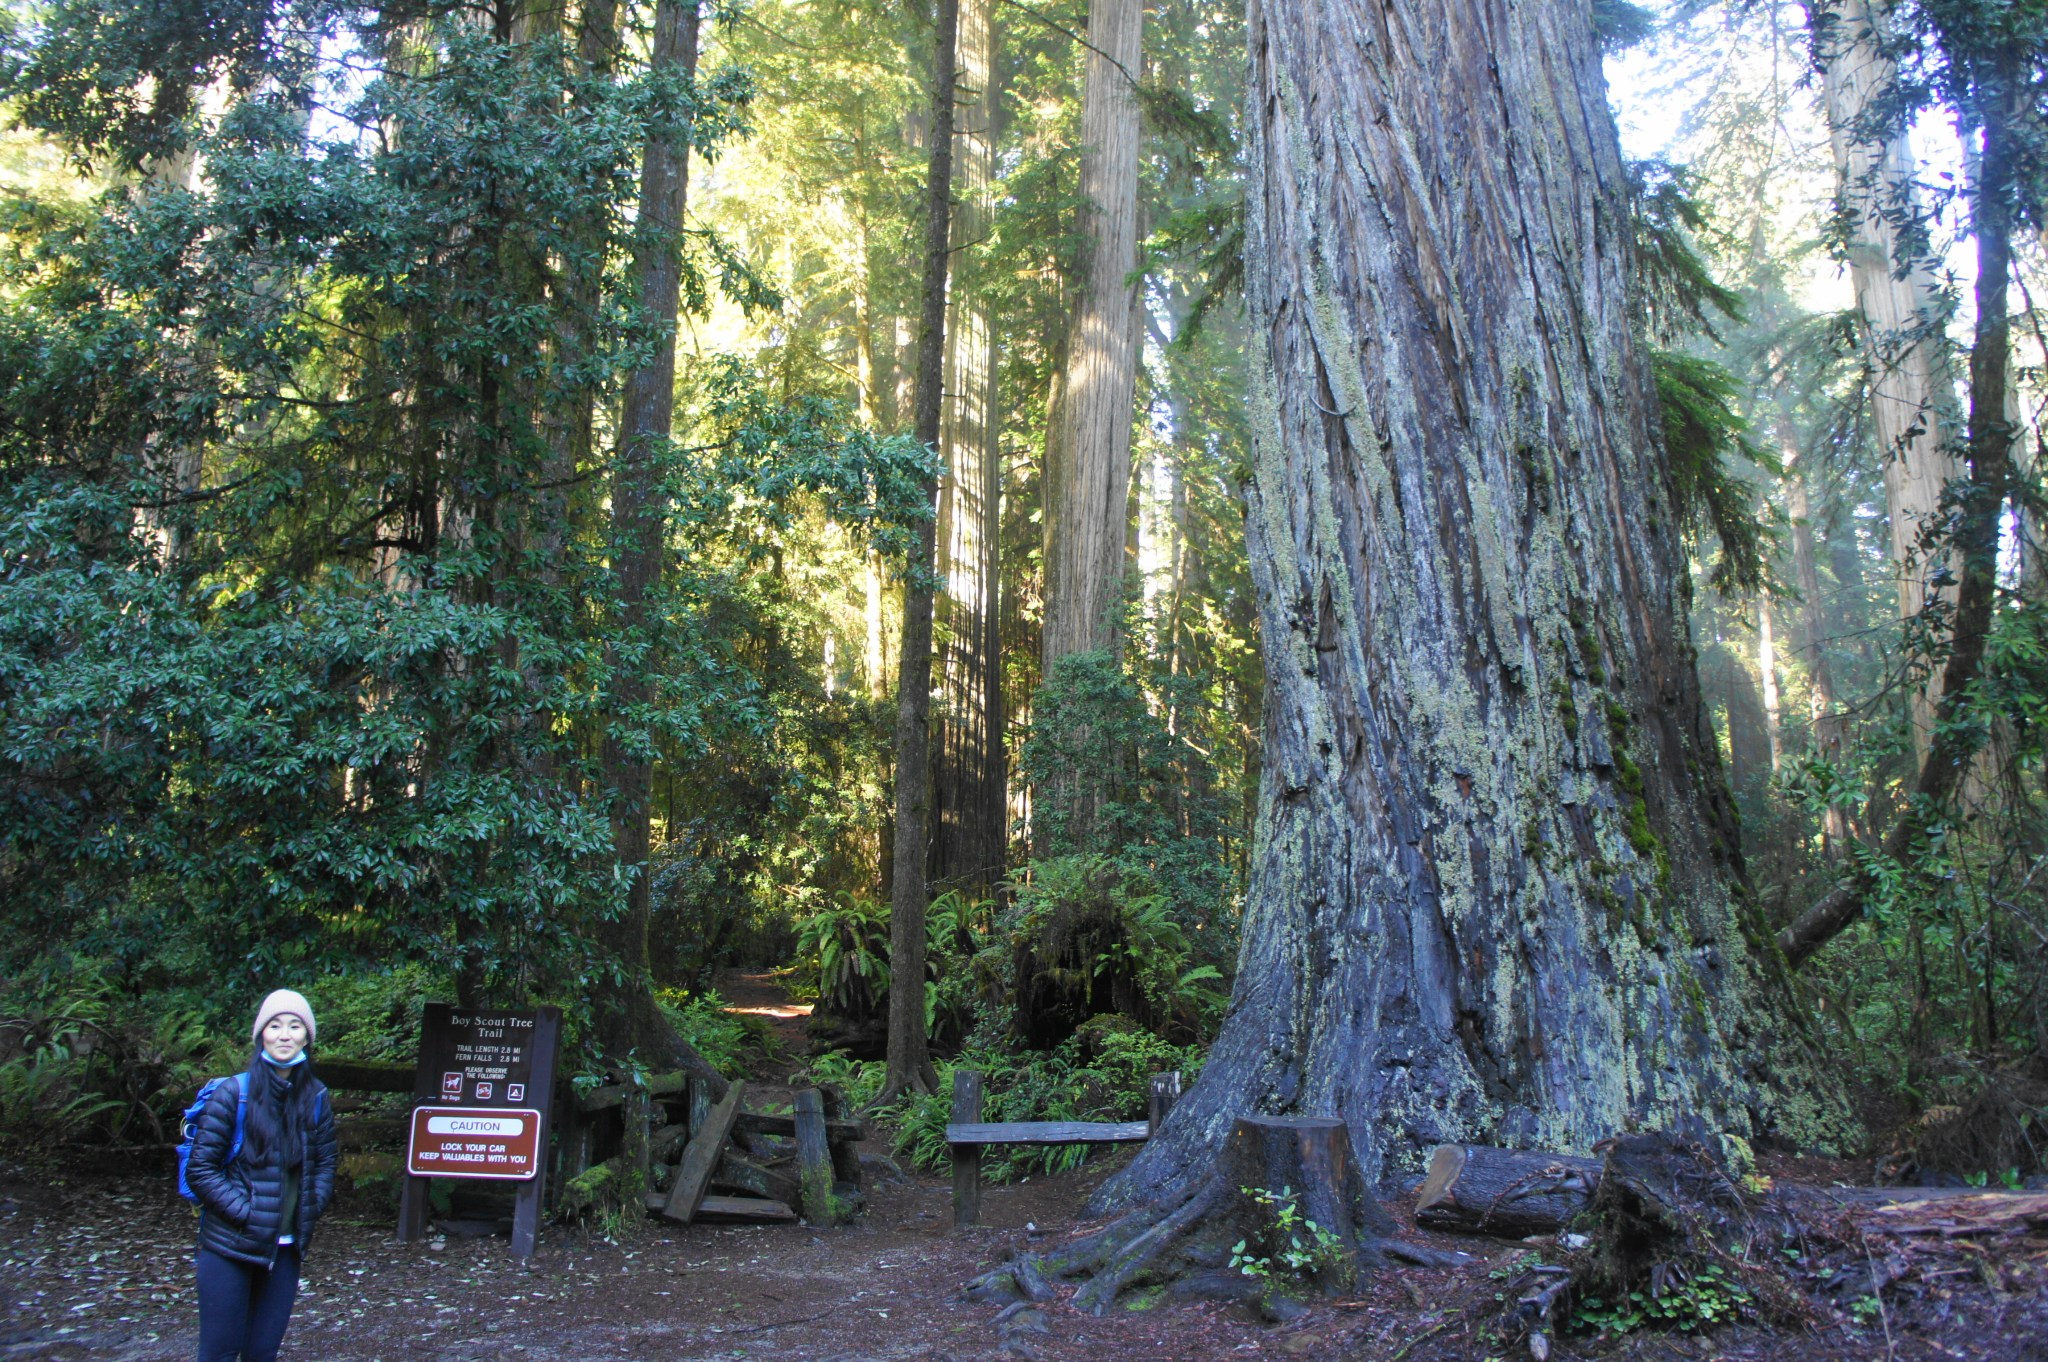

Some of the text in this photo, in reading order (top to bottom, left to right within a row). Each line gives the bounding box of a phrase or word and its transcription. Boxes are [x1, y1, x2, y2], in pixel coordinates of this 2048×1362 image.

[451, 1016, 533, 1028] Boy Scout Tree
[478, 1028, 503, 1038] Trail
[457, 1045, 473, 1053] TRAIL
[476, 1045, 499, 1054] LENGTH
[474, 1054, 492, 1062] FALLS
[450, 1121, 500, 1132] CAUTION
[441, 1143, 506, 1153] LOCK YOUR CAR
[419, 1152, 527, 1164] KEEP VALUABLES WITH YOU
